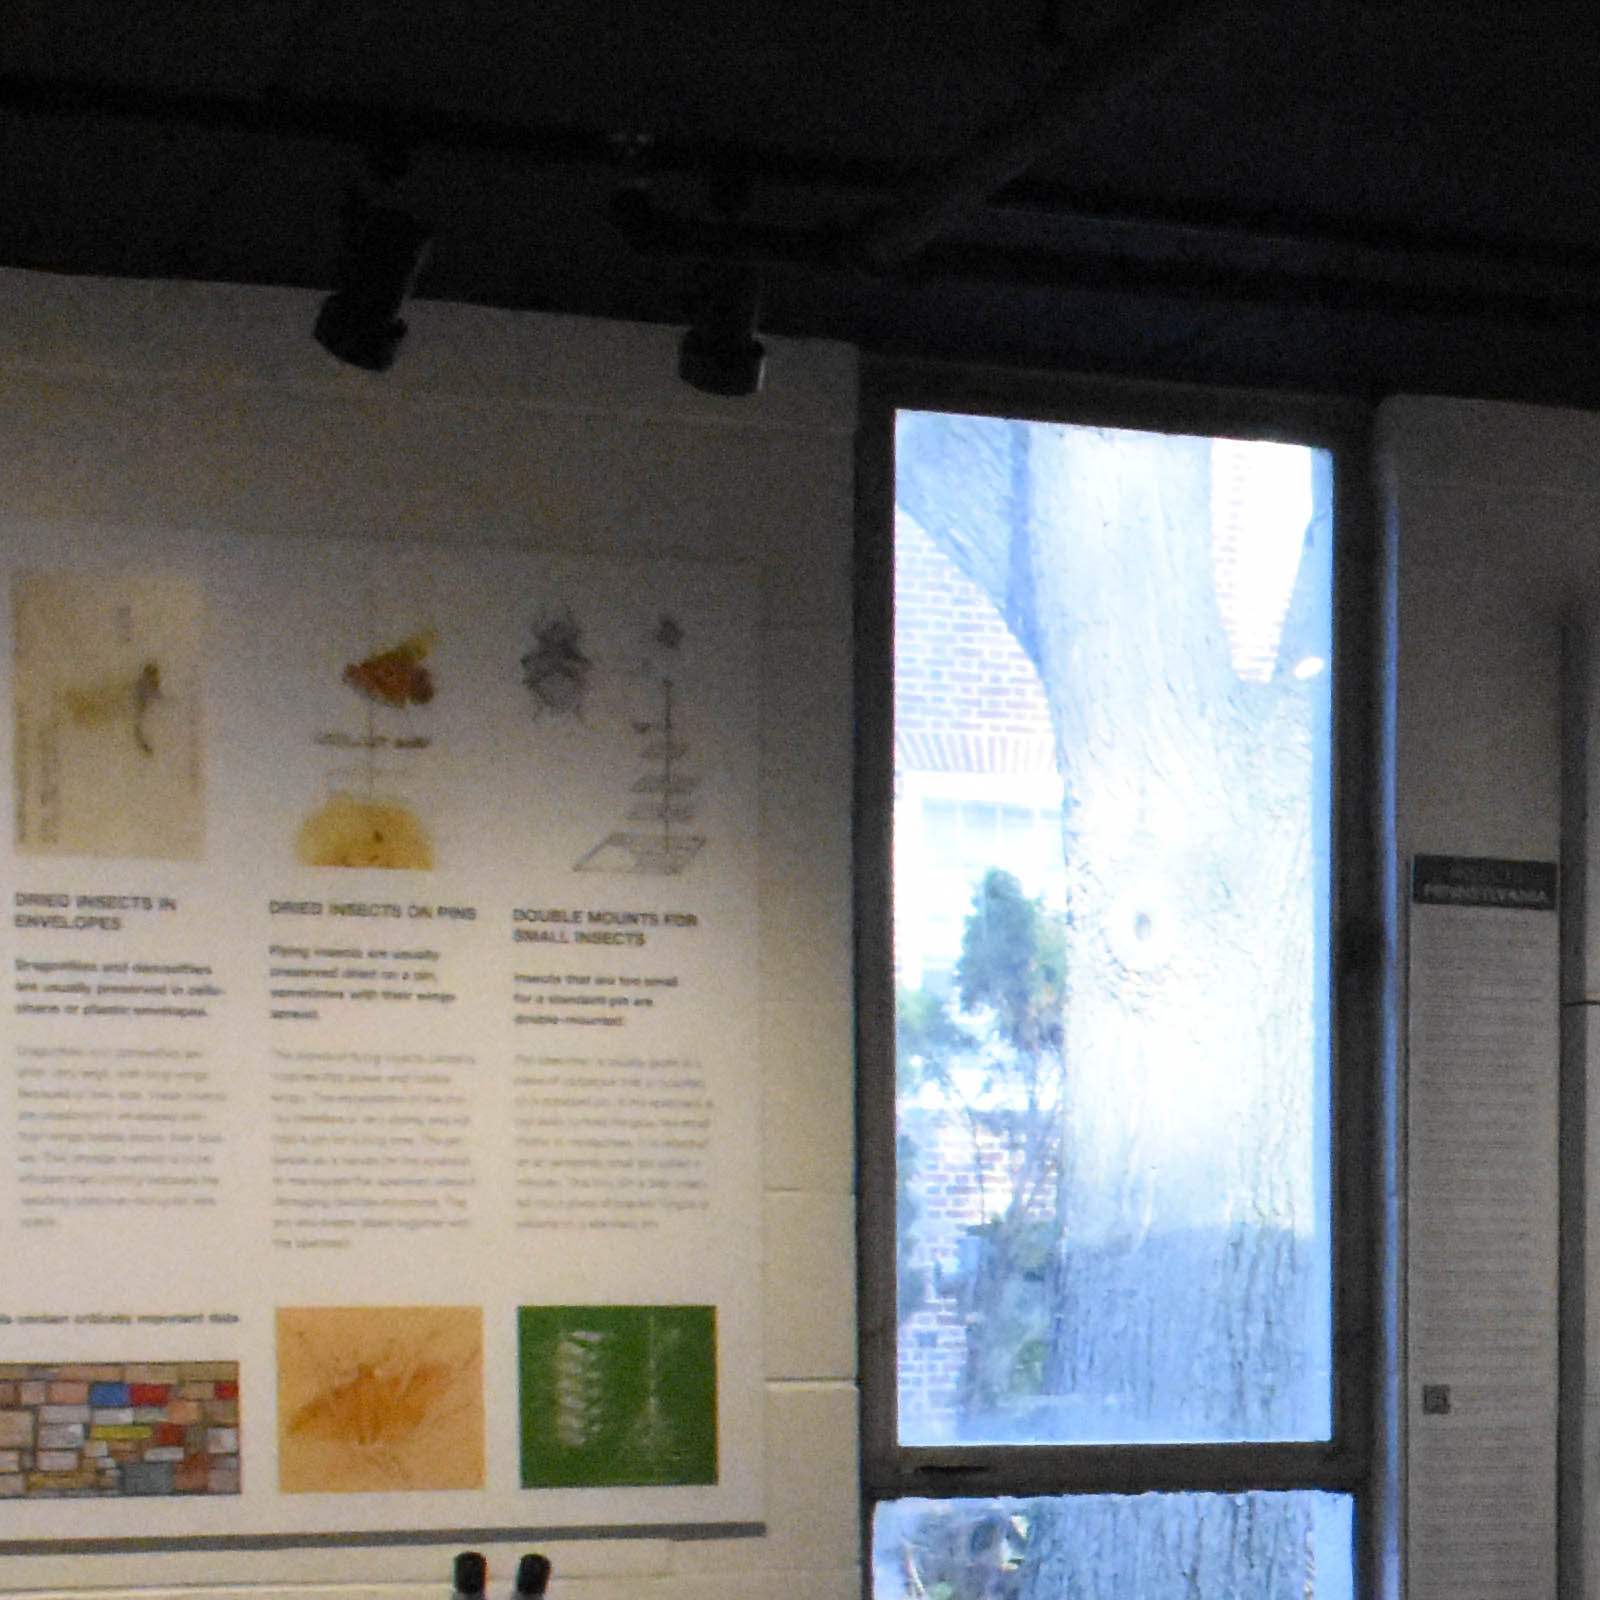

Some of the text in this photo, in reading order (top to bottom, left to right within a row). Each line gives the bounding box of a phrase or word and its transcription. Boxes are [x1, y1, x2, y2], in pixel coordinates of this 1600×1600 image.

[15, 914, 121, 931] ENVELOPES
[513, 908, 582, 924] DOUBLE
[587, 910, 659, 925] MOUNTS
[513, 928, 646, 946] SMALL INSECTS
